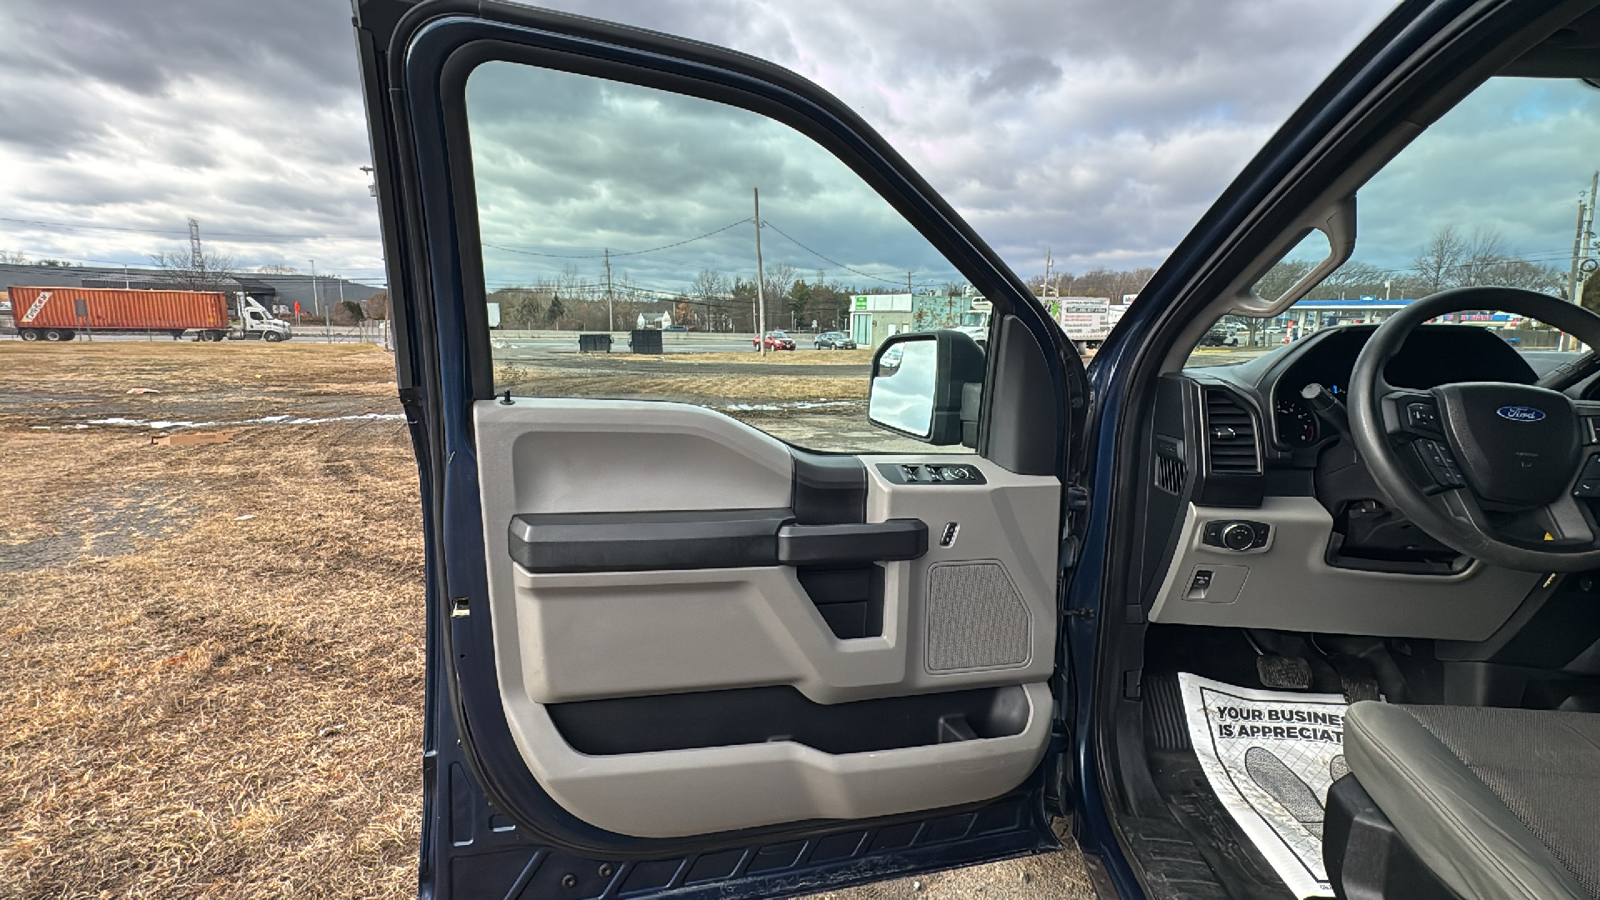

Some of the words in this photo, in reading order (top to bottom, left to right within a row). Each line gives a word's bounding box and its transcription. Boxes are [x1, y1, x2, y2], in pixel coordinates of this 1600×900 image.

[1507, 407, 1536, 419] Ford
[1217, 706, 1263, 721] YOUR
[1268, 709, 1345, 727] BUSINE
[1218, 724, 1234, 738] IS
[1238, 724, 1344, 744] APPRECIAT
